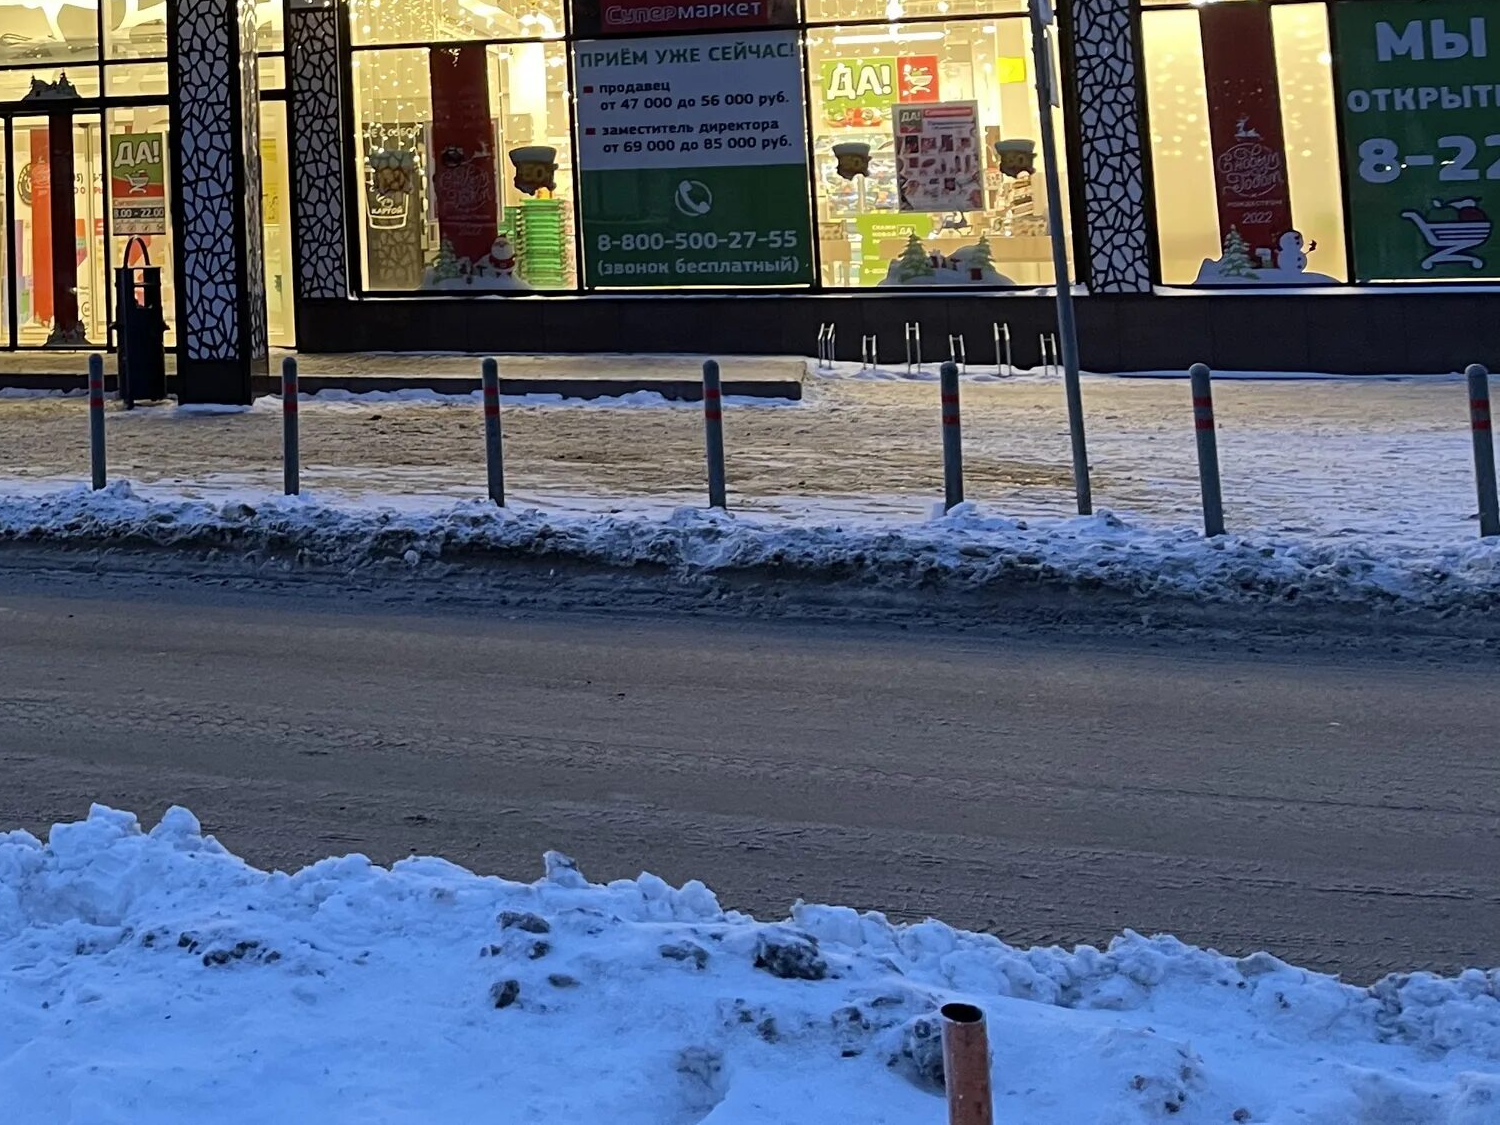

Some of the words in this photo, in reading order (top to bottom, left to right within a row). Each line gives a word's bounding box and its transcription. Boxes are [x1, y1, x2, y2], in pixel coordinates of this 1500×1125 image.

[606, 2, 761, 25] Супермаркет
[1375, 17, 1487, 62] МЫ
[580, 48, 648, 68] ПРИЁМ
[655, 48, 701, 64] УЖЕ
[708, 42, 795, 62] СЕЙЧАС!
[600, 81, 671, 95] продавец
[827, 64, 893, 100] ДА!
[600, 100, 619, 111] от
[620, 98, 640, 109] 47
[644, 97, 672, 109] 000
[677, 98, 696, 110] до
[701, 95, 720, 106] 56
[725, 94, 754, 105] 000
[758, 91, 789, 107] руб.
[1347, 84, 1500, 112] ОТКРЫТ
[602, 123, 694, 136] заместитель
[699, 119, 779, 135] директора
[114, 141, 160, 167] ДА!
[603, 142, 619, 154] от
[623, 141, 642, 153] 69
[646, 139, 675, 152] 000
[680, 140, 699, 153] до
[704, 138, 723, 150] 85
[727, 137, 756, 149] 000
[761, 135, 792, 150] руб.
[597, 230, 798, 252] 8-800-500-27-55
[597, 259, 669, 276] (звонок
[674, 256, 800, 275] бесплатный)
